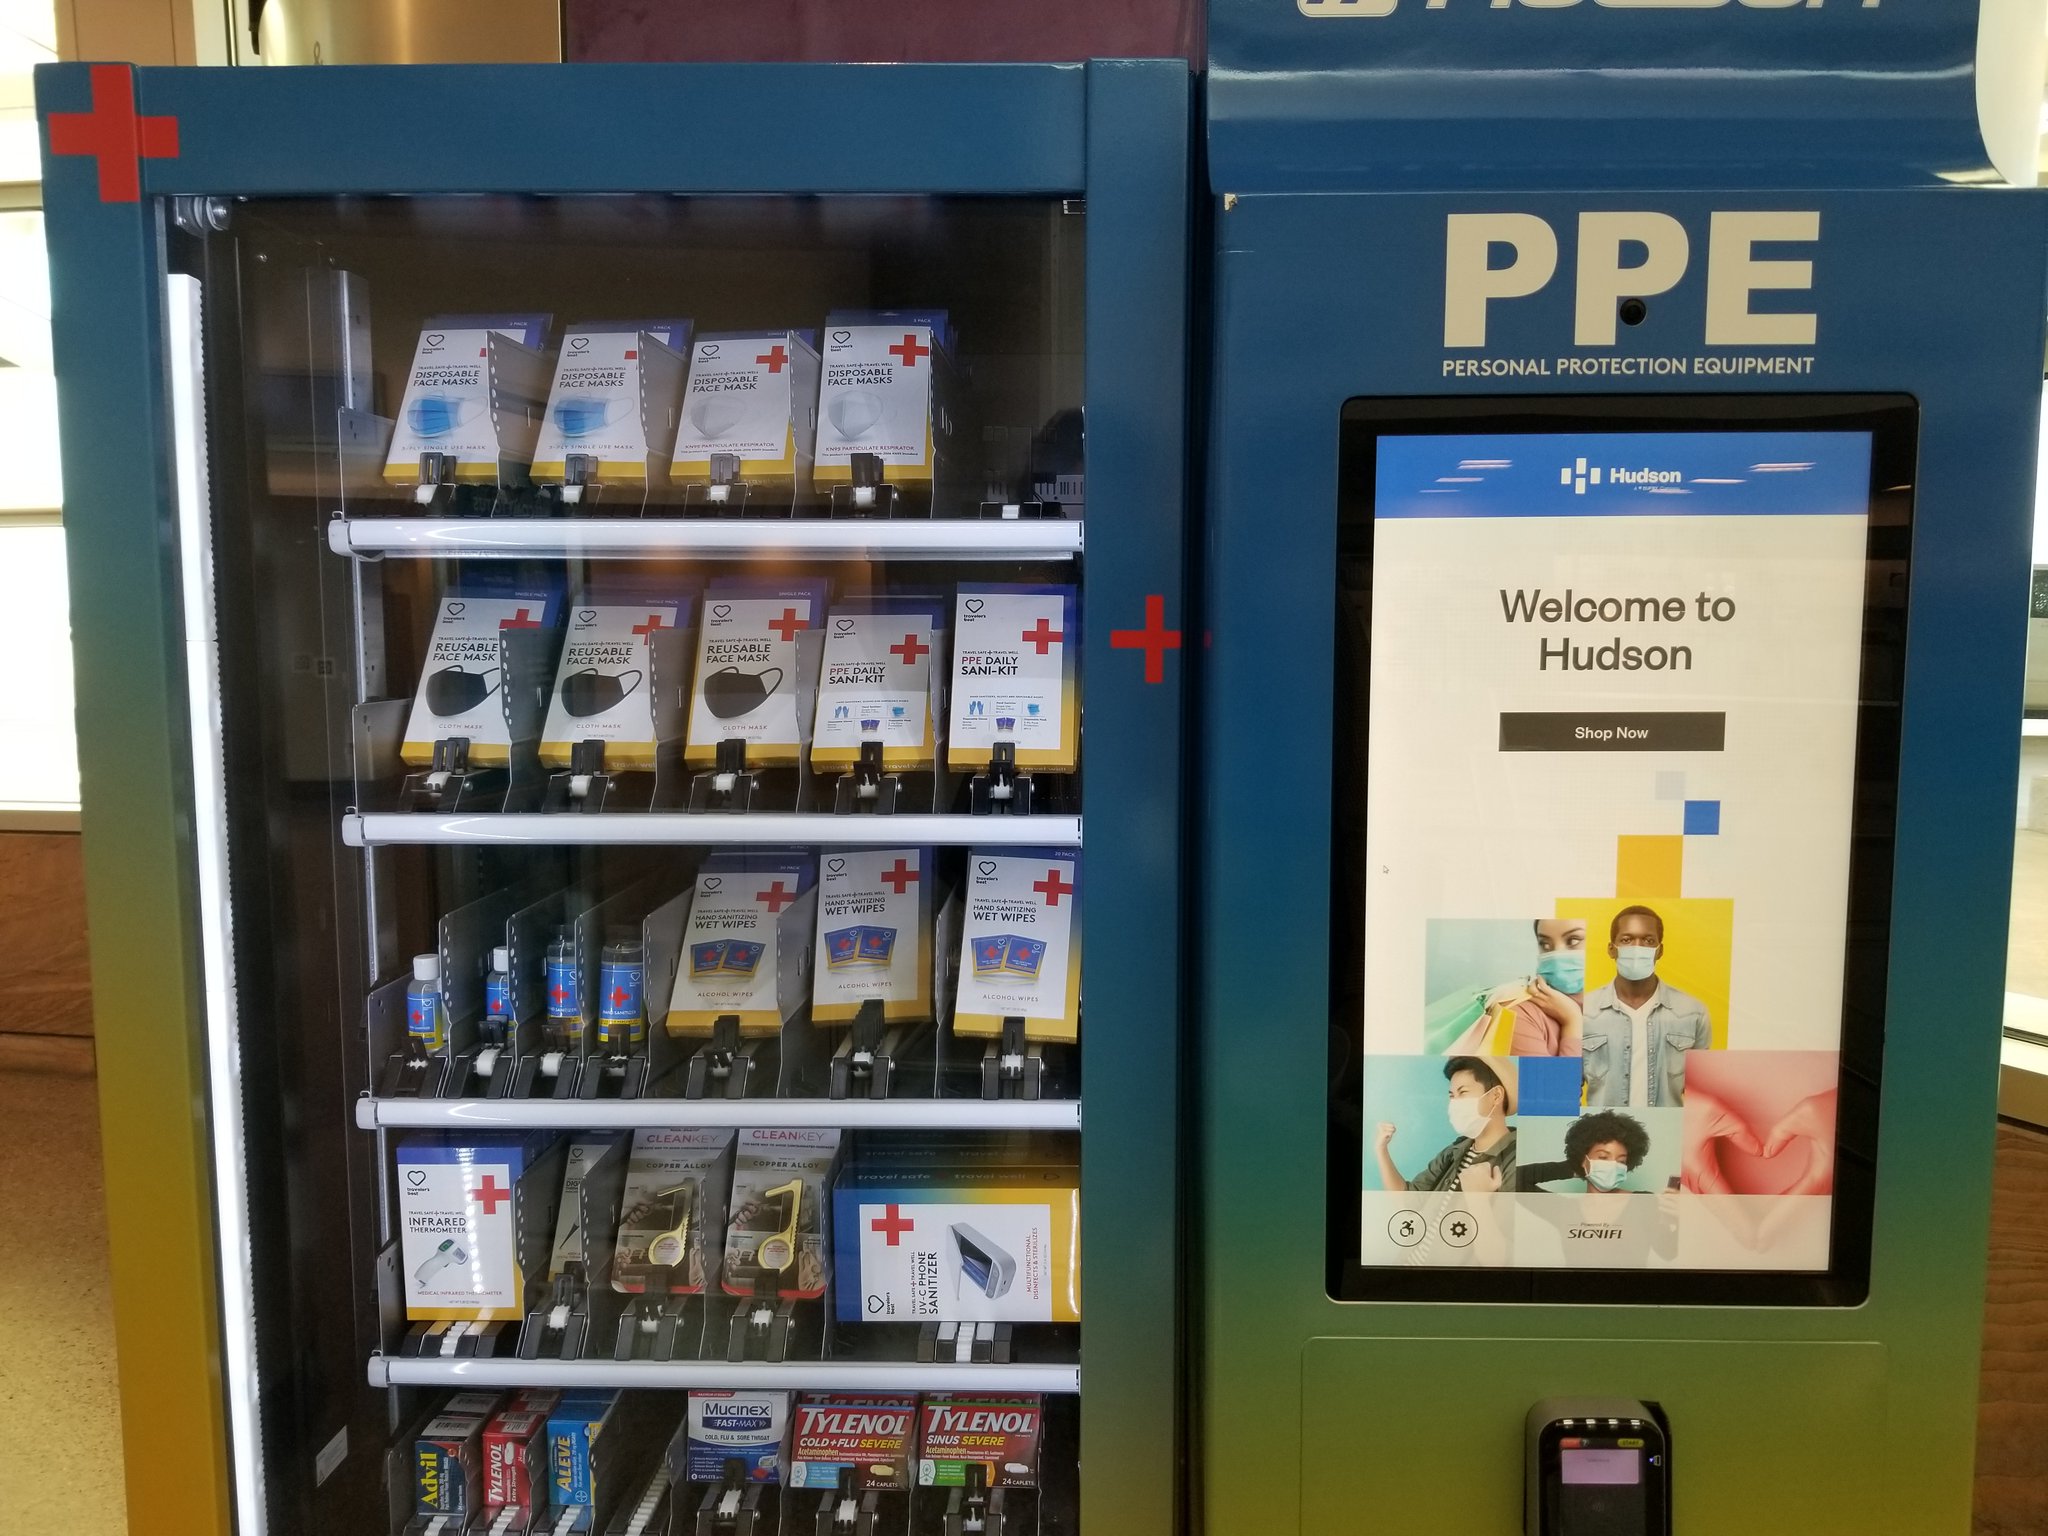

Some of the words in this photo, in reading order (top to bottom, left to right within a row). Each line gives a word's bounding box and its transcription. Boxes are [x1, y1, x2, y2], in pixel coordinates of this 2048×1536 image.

[1443, 210, 1821, 348] PPE
[1442, 358, 1551, 377] PERSONAL
[1557, 357, 1687, 375] PROTECTION
[1693, 356, 1815, 374] EQUIPMENT
[415, 370, 481, 379] DISPOSABLE
[561, 372, 626, 381] DISPOSABLE
[828, 368, 893, 378] DISPOSABLE
[413, 379, 439, 387] FACE
[441, 378, 479, 386] MASKS
[559, 381, 585, 389] FACE
[587, 379, 624, 388] MASKS
[694, 375, 759, 385] DISPOSABLE
[827, 377, 854, 386] FACE
[856, 376, 893, 385] MASKS
[692, 385, 721, 393] FACE
[723, 382, 757, 391] MASK
[1610, 467, 1682, 484] Hudson
[1499, 588, 1685, 624] Welcome
[1695, 591, 1736, 623] to
[435, 642, 499, 652] REUSABLE
[568, 647, 633, 657] REUSABLE
[707, 643, 772, 654] REUSABLE
[432, 653, 461, 661] FACE
[463, 652, 497, 661] MASK
[706, 654, 734, 664] FACE
[737, 653, 770, 663] MASK
[1539, 637, 1693, 672] Hudson
[566, 657, 595, 666] FACE
[597, 656, 631, 665] MASK
[961, 656, 982, 665] PPE
[985, 656, 1019, 665] DAILY
[829, 667, 850, 676] PPE
[853, 666, 886, 675] DAILY
[961, 666, 1019, 676] SANI-KIT
[828, 675, 886, 685] SANI-KIT
[1574, 725, 1612, 742] Shop
[1616, 726, 1649, 739] Now
[825, 899, 845, 907] HAND
[846, 897, 886, 905] SANITIZING
[825, 906, 849, 916] WET
[851, 904, 885, 914] WIPES
[996, 905, 1037, 913] SANITIZING
[973, 911, 998, 921] WET
[1000, 912, 1036, 923] WIPES
[694, 921, 720, 929] WET
[722, 920, 757, 929] WIPES
[647, 1134, 720, 1143] CLEANKEY
[752, 1129, 825, 1141] CLEANKEY
[753, 1160, 788, 1168] COPPER
[408, 1217, 467, 1226] INFRARED
[1567, 1228, 1623, 1239] SIGNIFI
[917, 1251, 927, 1287] PHONE
[927, 1252, 939, 1315] SANITIZER
[918, 1289, 927, 1315] UV-C
[714, 1419, 757, 1427] FAST-MAX
[800, 1407, 907, 1436] TYLENOL
[927, 1405, 1033, 1434] TYLENOL
[859, 1439, 903, 1449] SEVERE
[926, 1435, 960, 1445] SINUS
[961, 1436, 1006, 1446] SEVERE
[797, 1447, 839, 1456] Acetaminophen
[925, 1446, 967, 1455] Acetaminophen
[556, 1436, 573, 1493] ALEVE
[488, 1443, 505, 1503] TYLENOL
[419, 1453, 438, 1508] Advil
